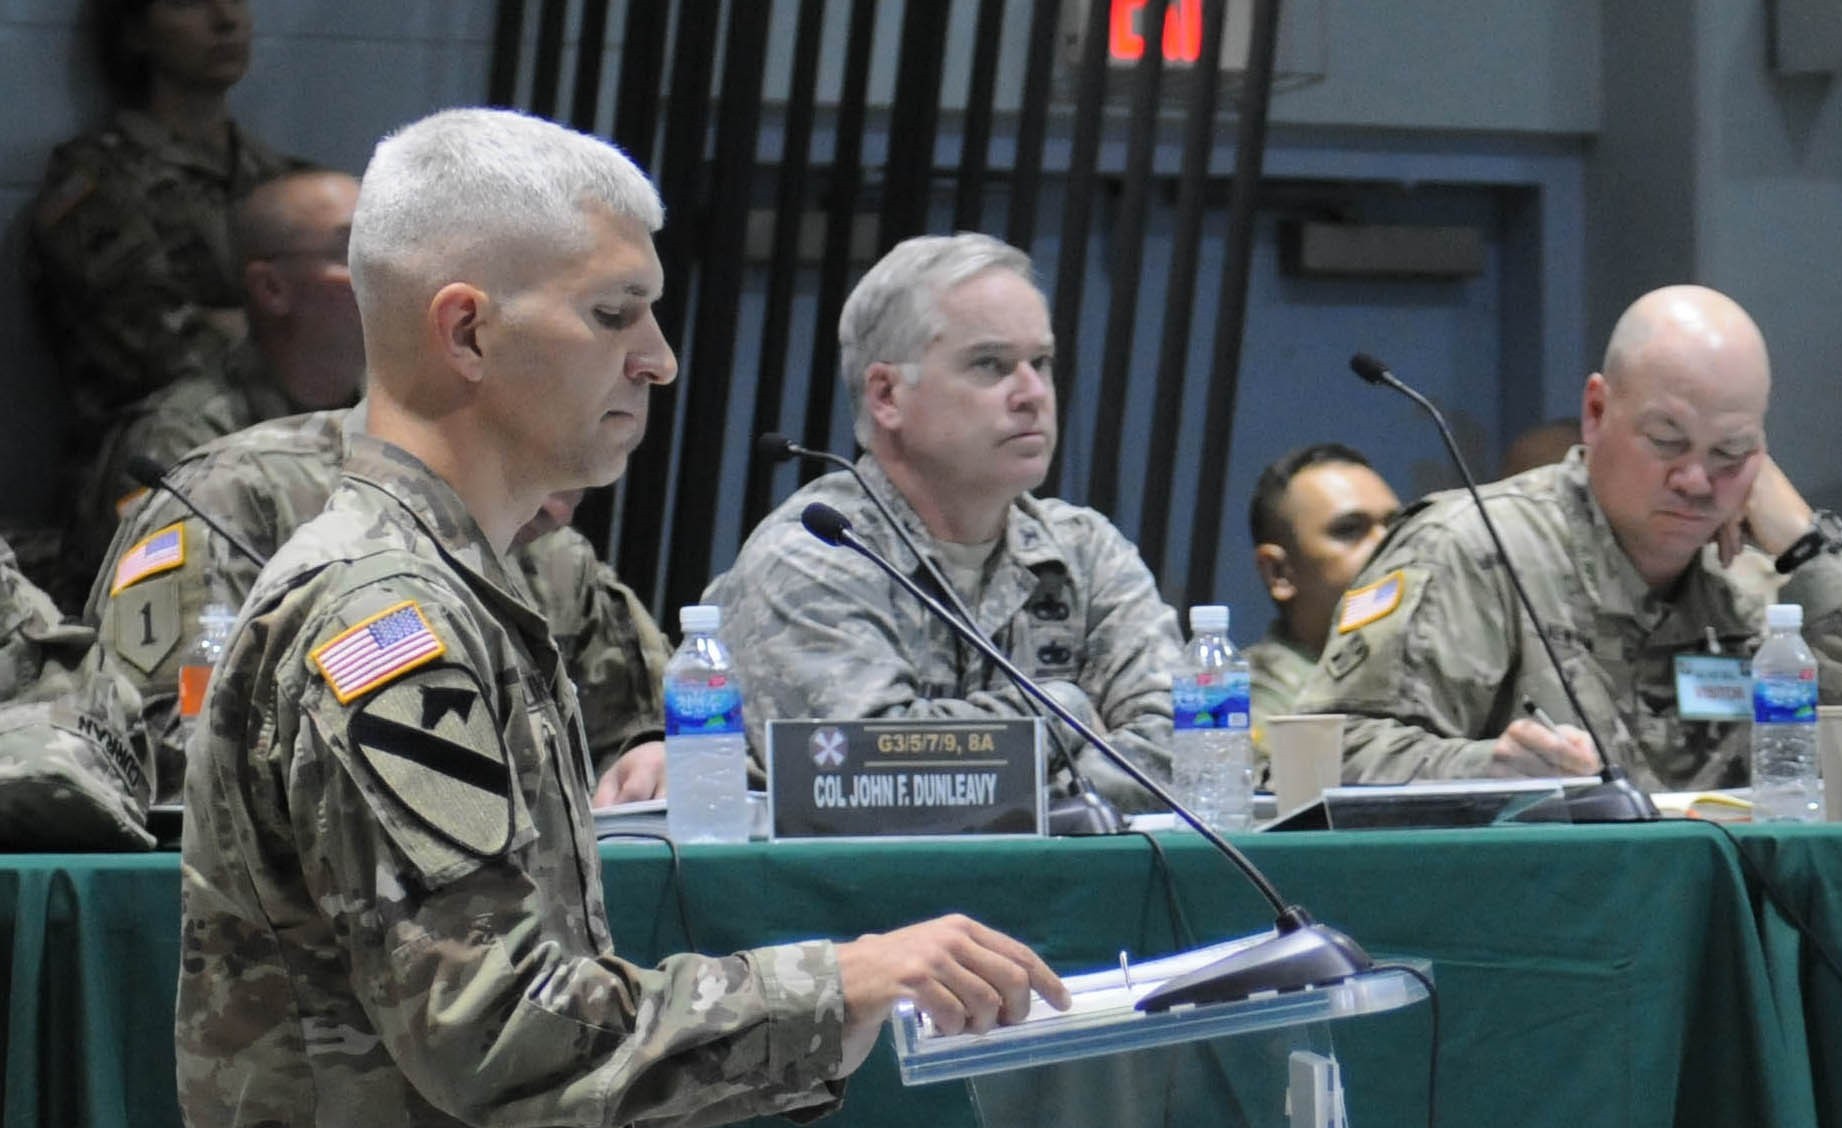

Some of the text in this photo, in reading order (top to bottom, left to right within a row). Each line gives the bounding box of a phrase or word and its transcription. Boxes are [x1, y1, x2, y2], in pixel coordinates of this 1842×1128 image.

[139, 601, 157, 647] 1
[877, 732, 995, 755] G3/5/7/9, 8A
[813, 773, 997, 808] COL JOHN F. DUNLEAVY
